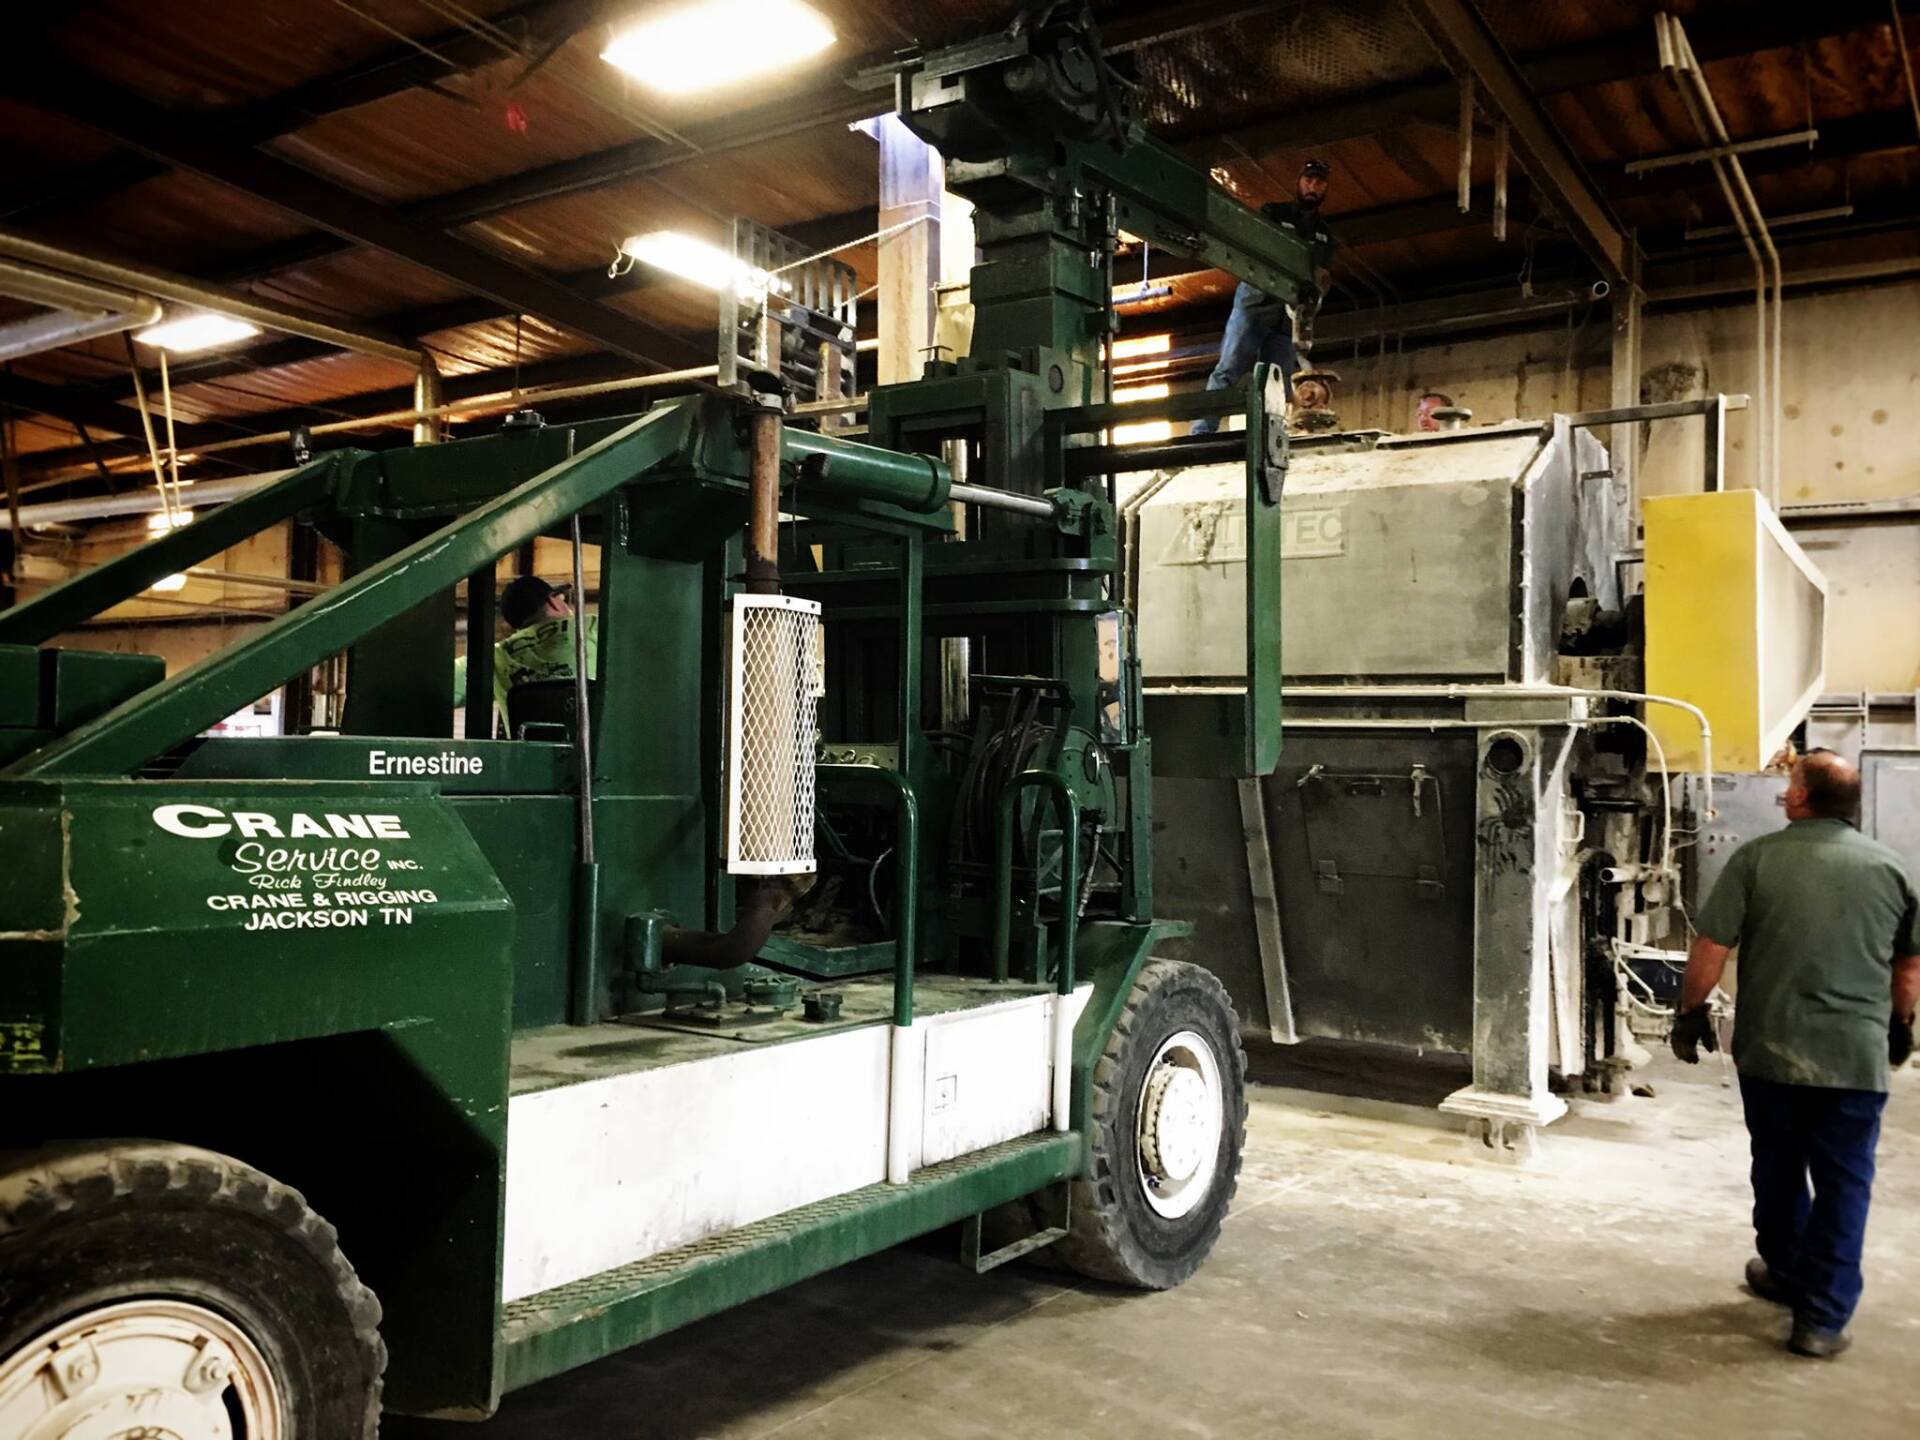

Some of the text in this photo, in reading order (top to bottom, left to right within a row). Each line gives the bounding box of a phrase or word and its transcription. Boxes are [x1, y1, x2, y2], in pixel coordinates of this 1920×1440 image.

[369, 750, 483, 775] Ernestine
[152, 804, 411, 839] CRANE
[231, 842, 424, 873] Service INC.
[248, 872, 387, 890] Rick Findley
[206, 889, 438, 911] CRANE & RIGGING
[244, 907, 413, 931] JACKSON TN
